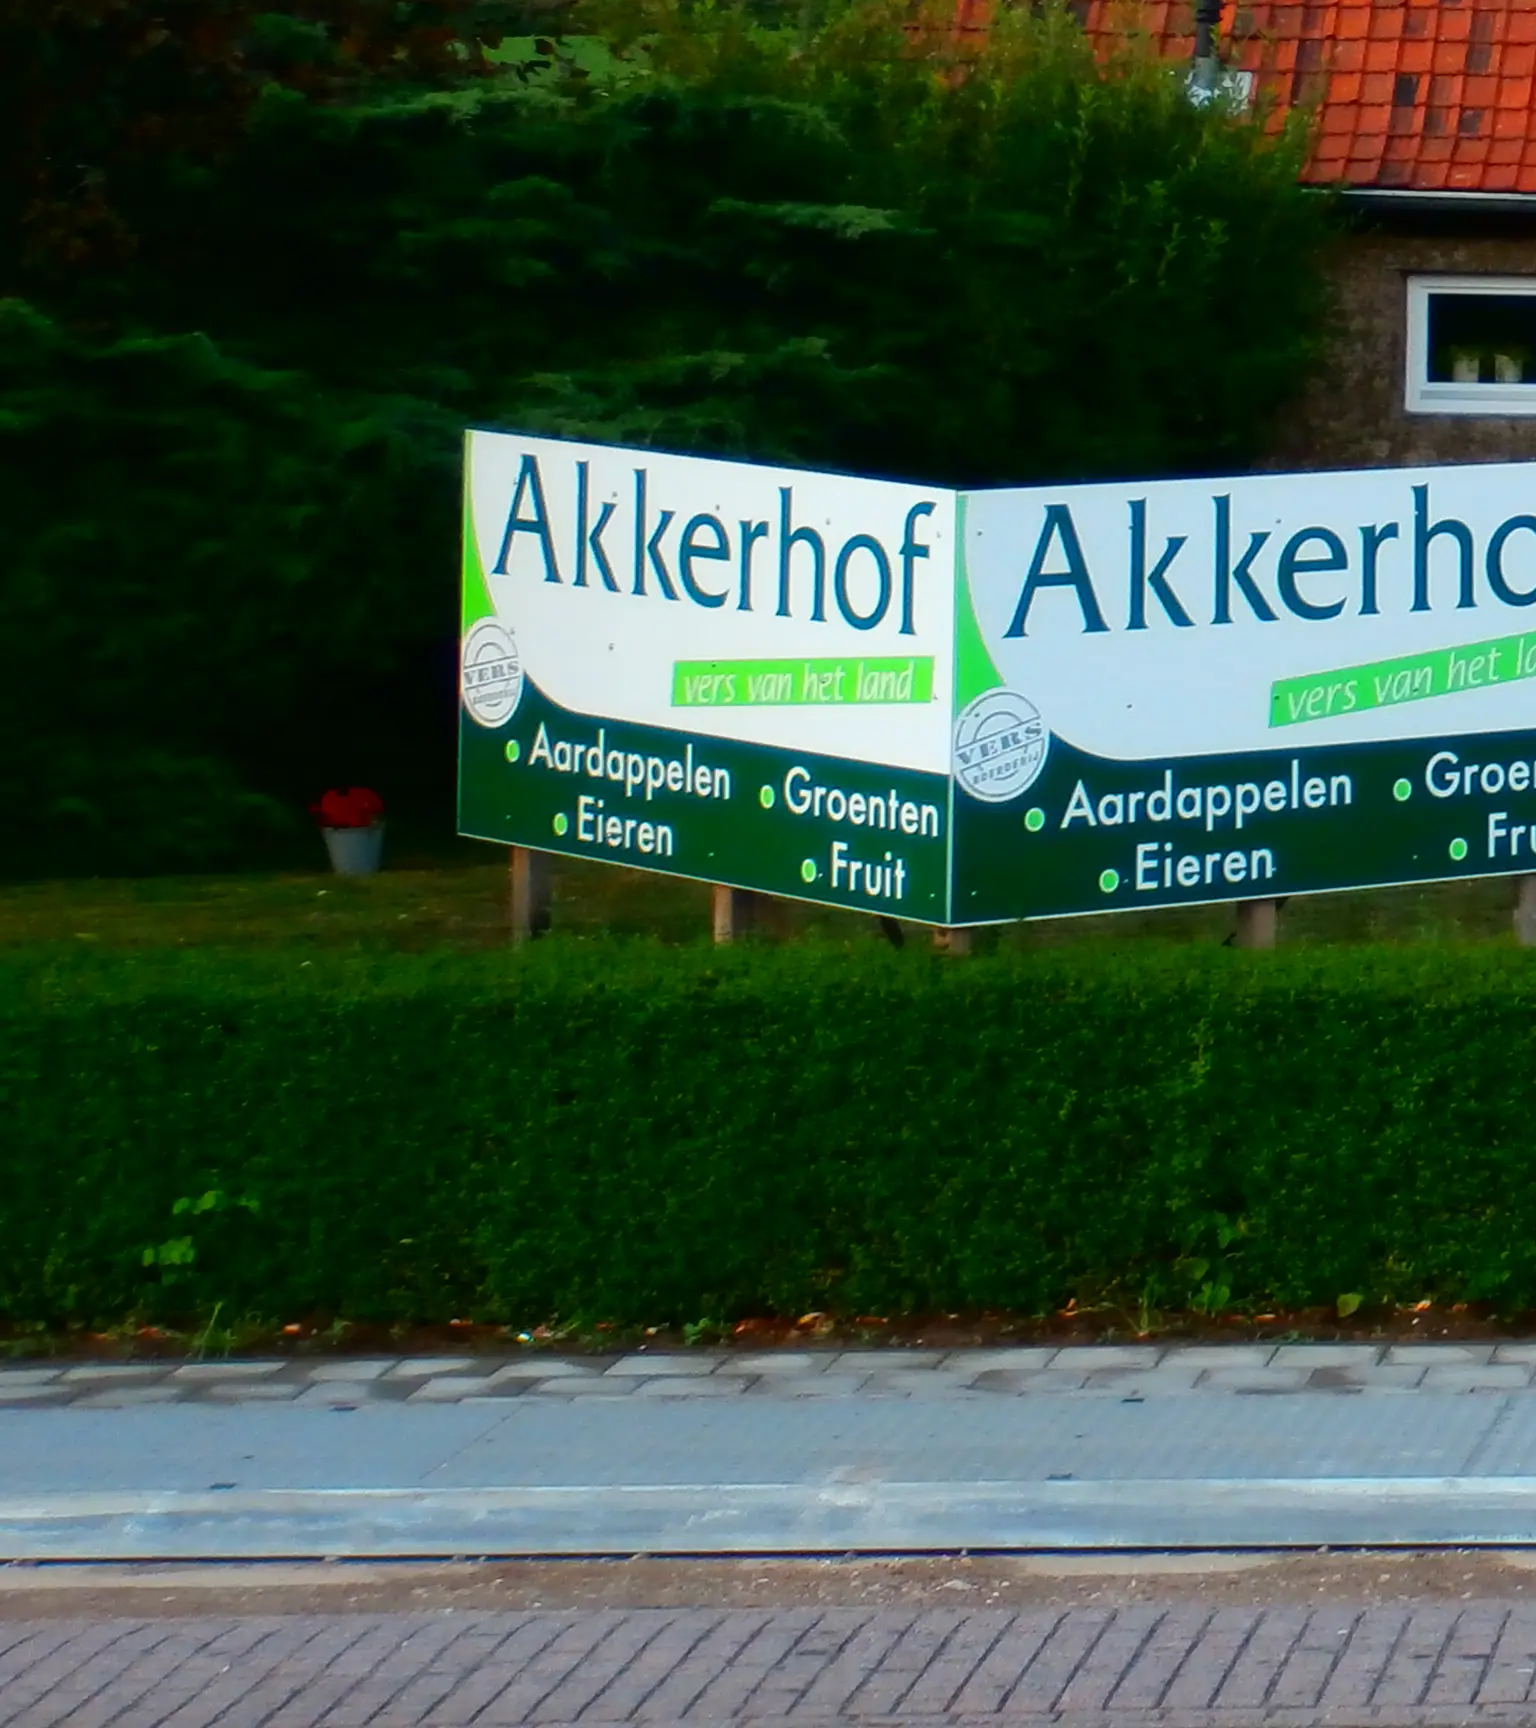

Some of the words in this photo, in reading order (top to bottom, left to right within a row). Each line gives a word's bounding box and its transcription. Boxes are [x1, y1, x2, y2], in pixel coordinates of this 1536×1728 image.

[490, 453, 938, 635] Akkerhof
[683, 674, 736, 703] vers
[748, 672, 793, 702] van
[802, 663, 846, 701] het
[857, 662, 914, 701] land
[1287, 677, 1357, 722] vers
[1374, 667, 1432, 704] van
[1447, 647, 1502, 688] het
[528, 722, 731, 801] Aardappelen
[957, 721, 1043, 765] VERS
[576, 796, 673, 857] Eieren
[784, 766, 939, 838] Groenten
[1060, 760, 1353, 832] Aardappelen
[831, 842, 906, 900] Fruit
[1135, 842, 1276, 891] Eieren
